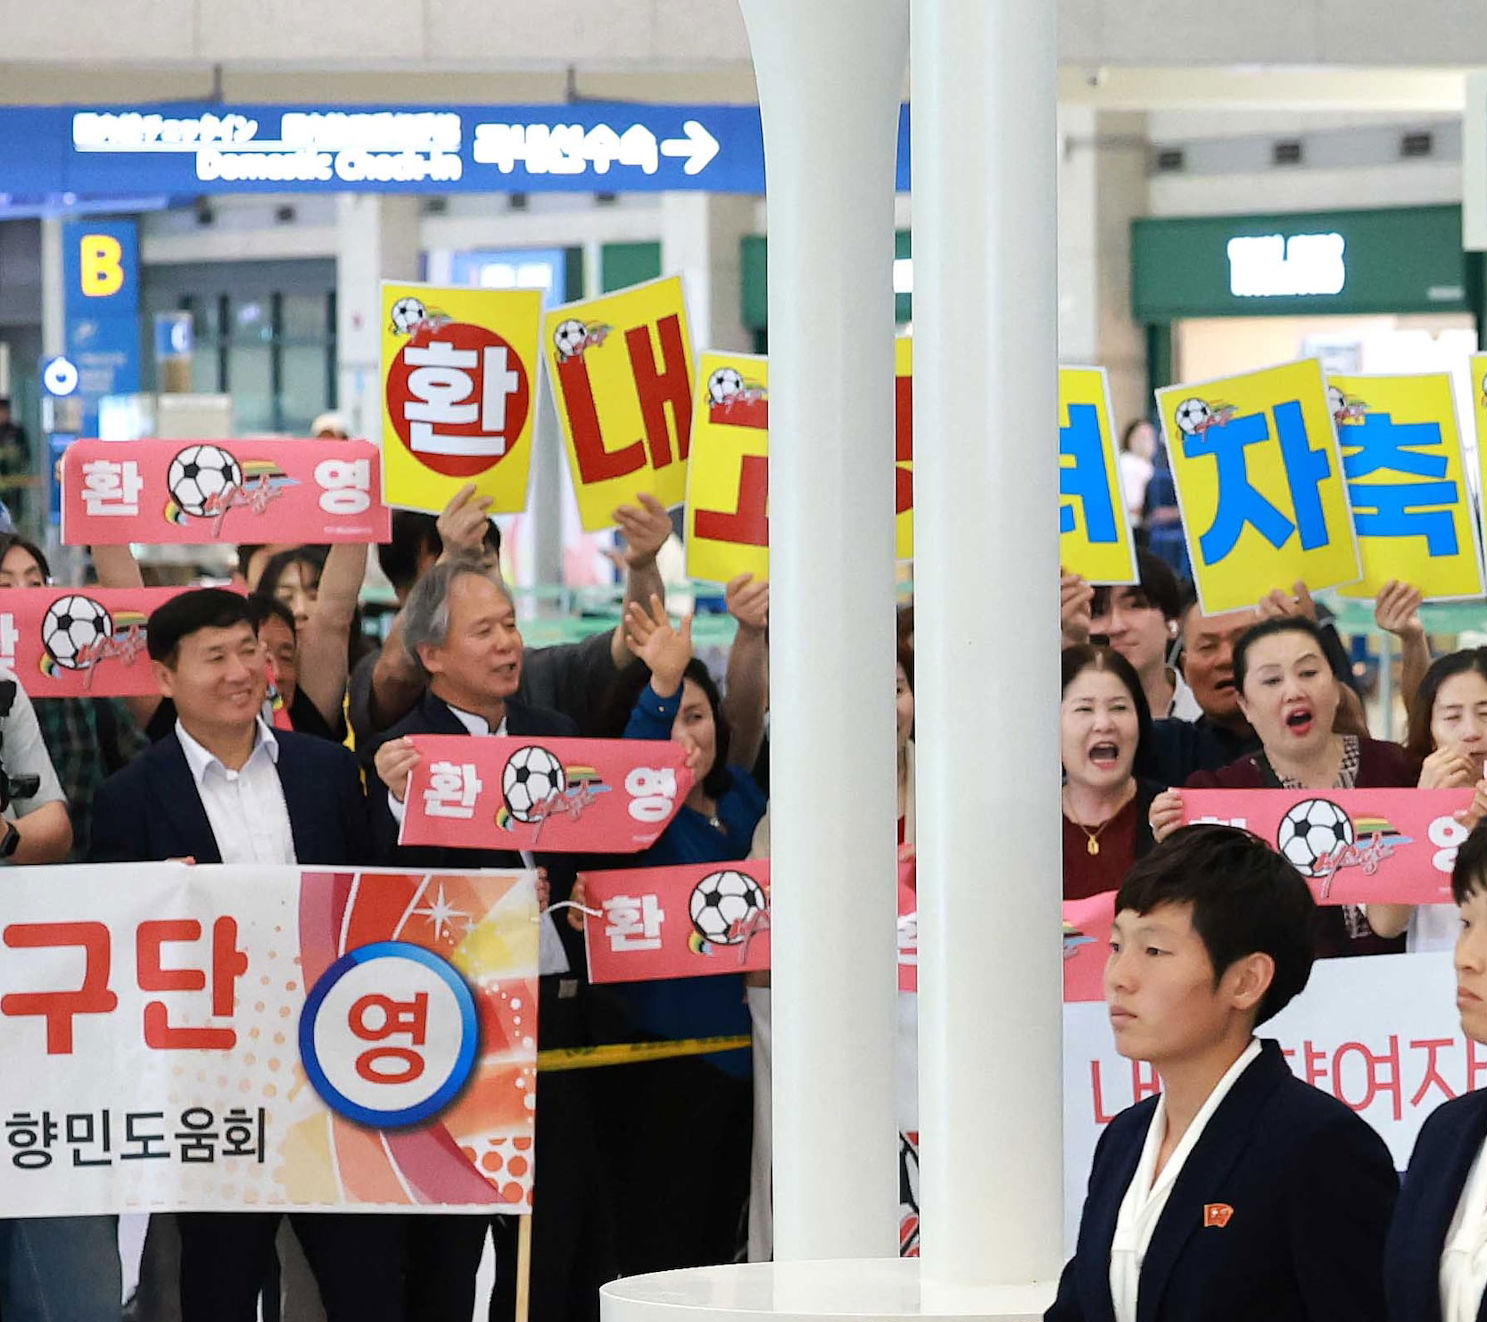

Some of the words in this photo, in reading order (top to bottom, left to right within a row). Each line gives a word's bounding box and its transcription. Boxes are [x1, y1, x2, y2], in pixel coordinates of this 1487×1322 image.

[80, 234, 125, 297] B
[403, 340, 519, 457] 환
[557, 313, 692, 485] 내
[81, 460, 143, 517] 환
[314, 458, 371, 515] 영
[1184, 400, 1331, 566] 자
[1340, 410, 1459, 558] 축
[423, 760, 483, 819] 환
[624, 766, 679, 823] 영
[602, 893, 665, 952] 환
[1, 915, 248, 1055] 구단
[347, 991, 429, 1085] 영
[5, 1106, 268, 1172] 향민도움회
